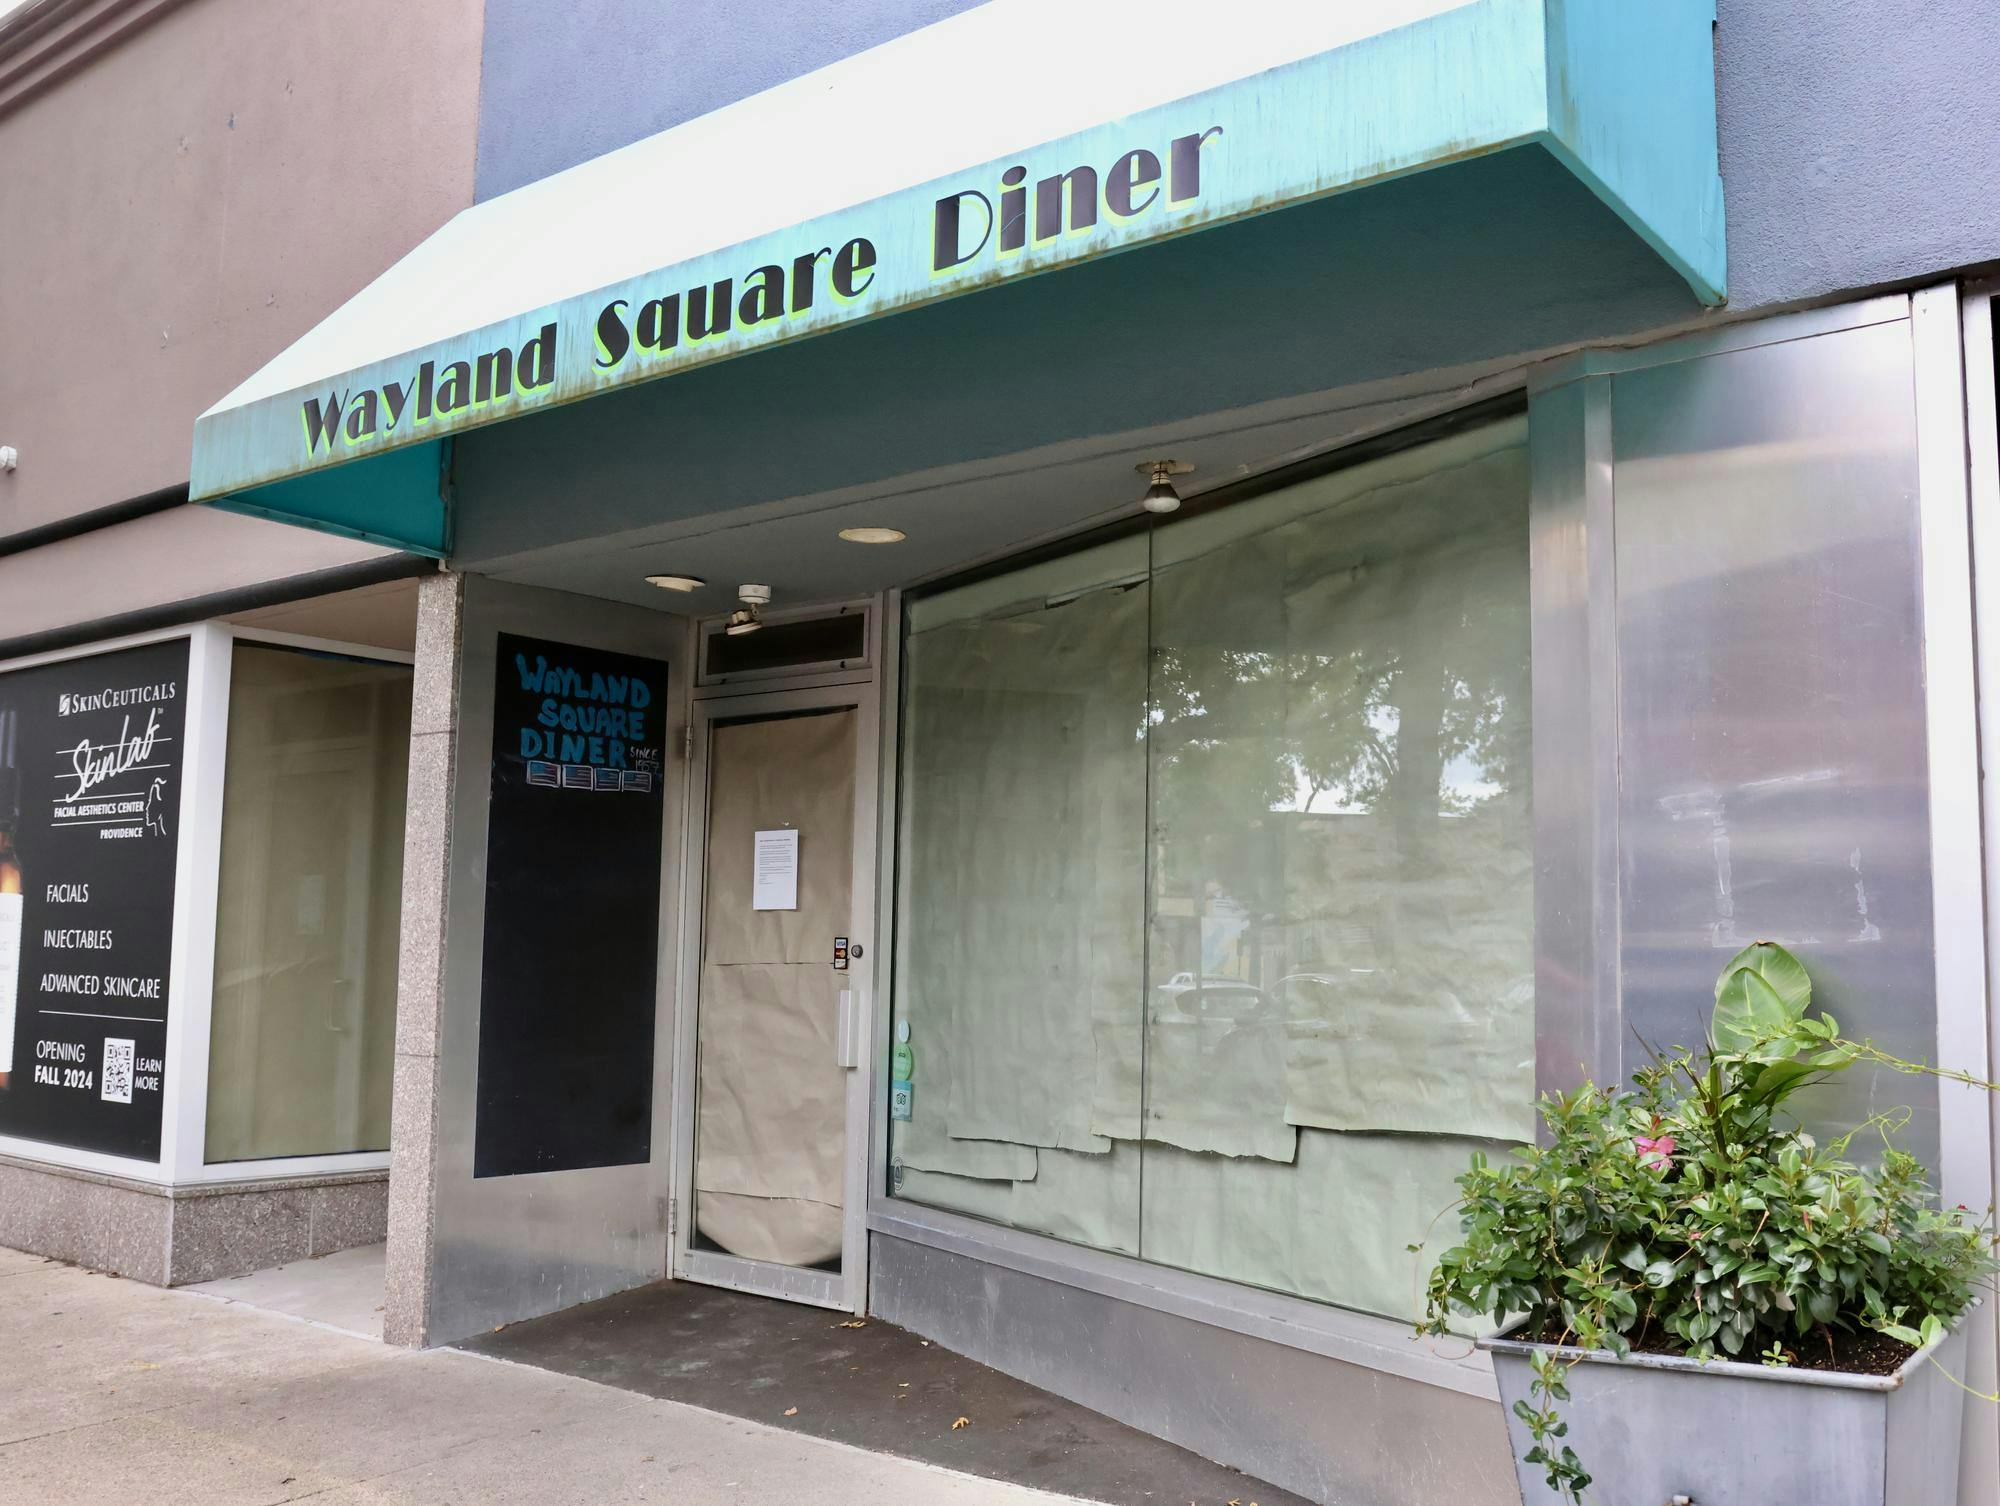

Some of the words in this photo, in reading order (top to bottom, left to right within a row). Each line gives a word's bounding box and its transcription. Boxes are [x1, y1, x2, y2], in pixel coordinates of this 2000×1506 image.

[302, 321, 558, 457] Wayland
[593, 237, 877, 370] Square
[932, 125, 1223, 275] Diner
[516, 653, 651, 709] WAYLAND
[537, 698, 646, 741] SQUARE
[520, 727, 627, 768] DINER
[630, 746, 659, 760] SINCE
[54, 805, 77, 818] FACIAL
[78, 803, 117, 817] AESTHETICS
[118, 801, 144, 813] CENTER
[100, 827, 143, 839] PROVIDENCE
[46, 884, 89, 903] FACIALS
[43, 930, 113, 949] INJECTABLES
[40, 974, 99, 995] ADVANCED
[103, 976, 161, 998] SKINCARE
[36, 1040, 86, 1063] OPENING
[136, 1058, 162, 1073] LEARN
[34, 1065, 60, 1086] FALL
[63, 1068, 93, 1090] 2024
[134, 1076, 159, 1091] MORE
